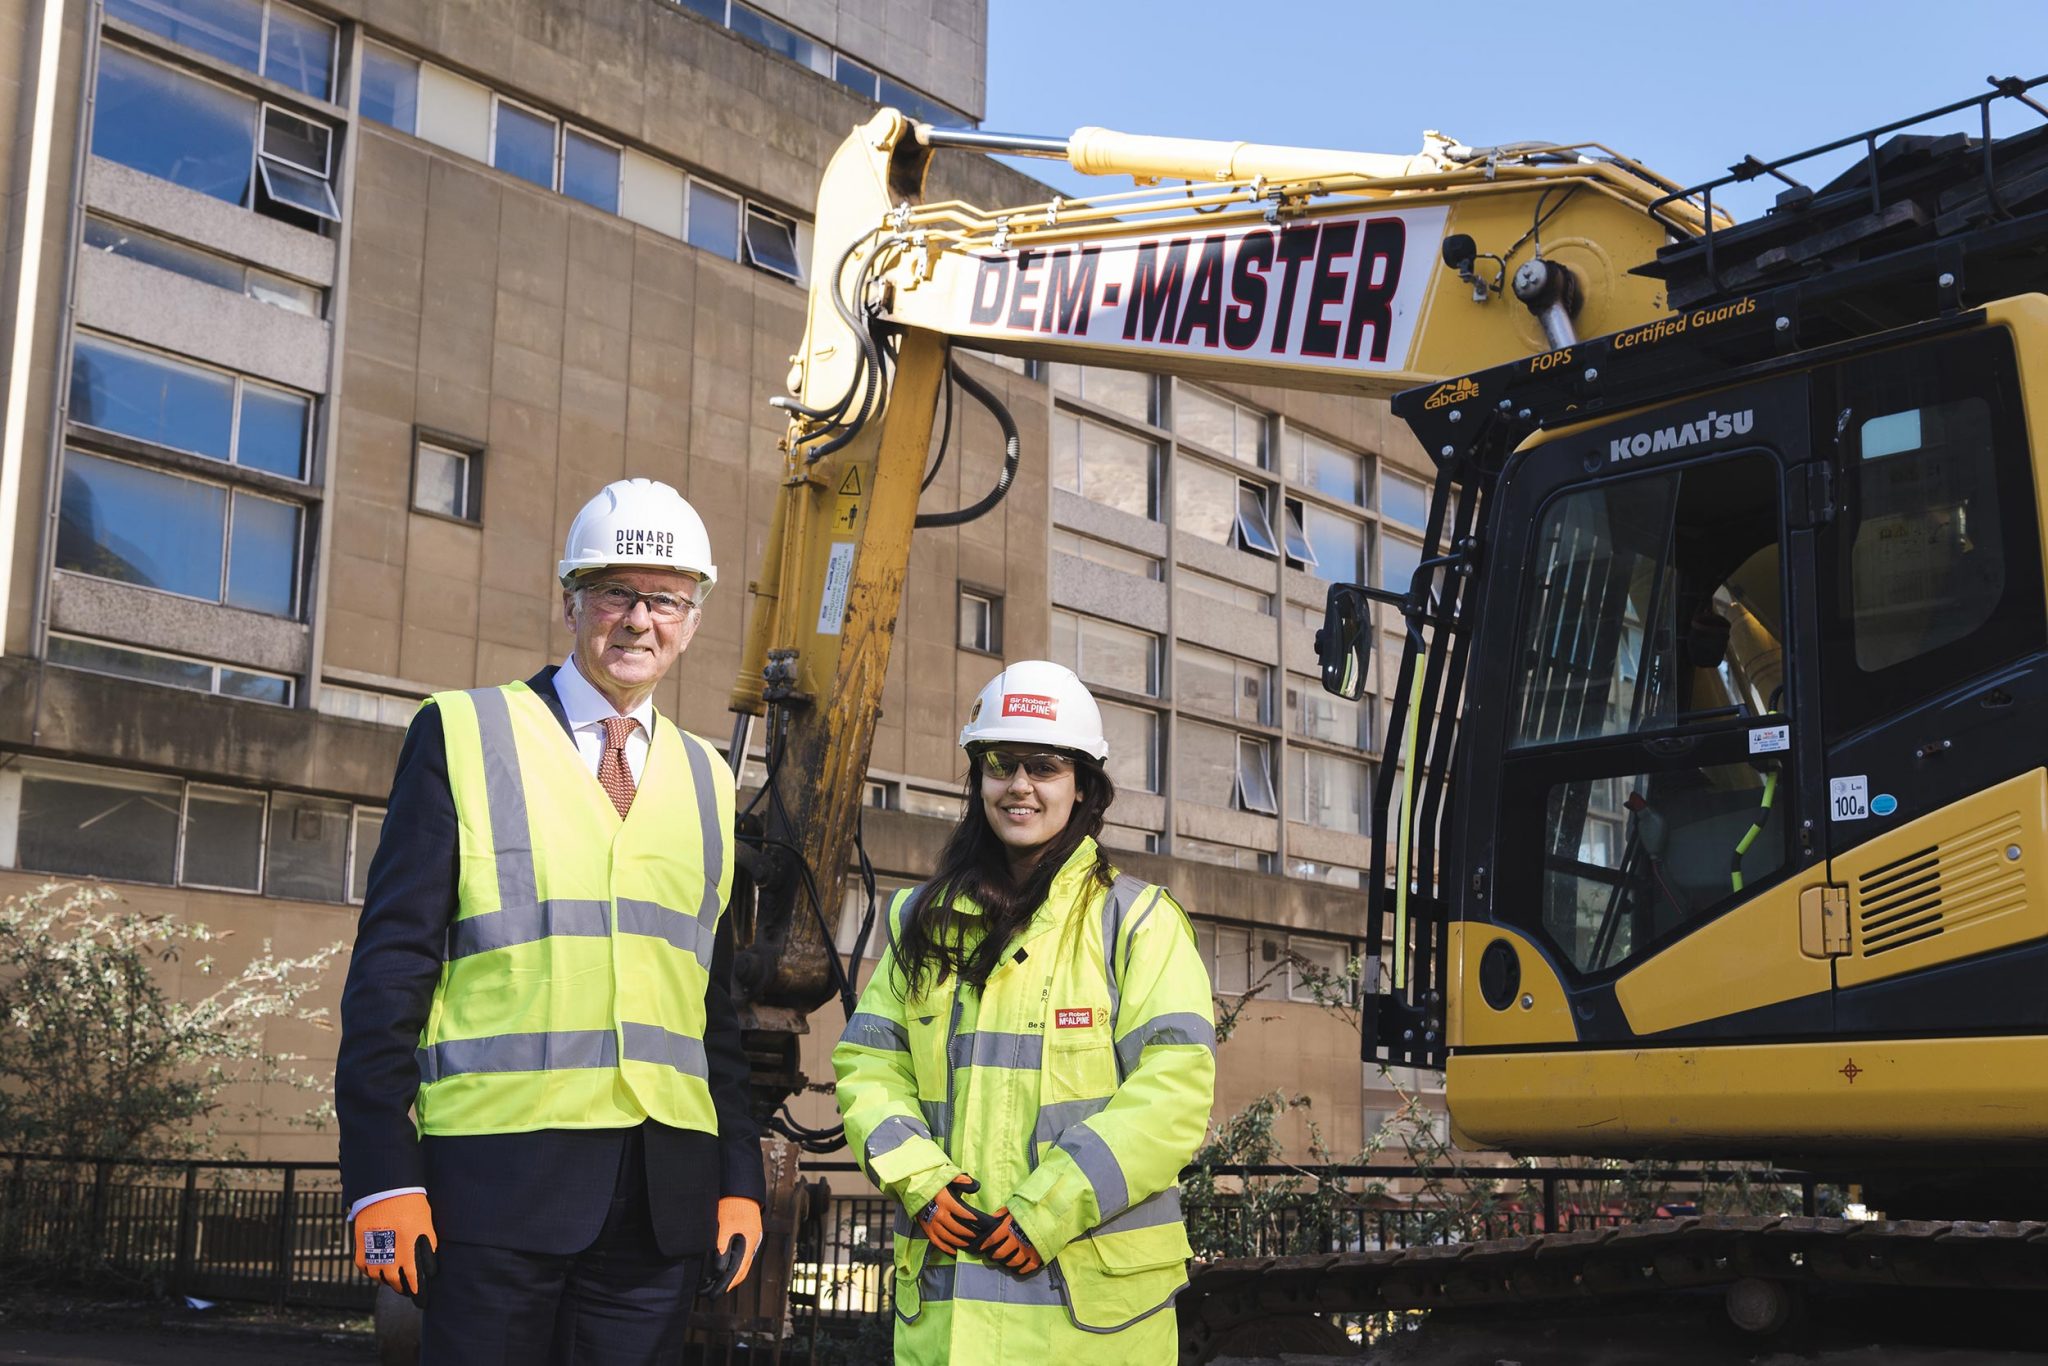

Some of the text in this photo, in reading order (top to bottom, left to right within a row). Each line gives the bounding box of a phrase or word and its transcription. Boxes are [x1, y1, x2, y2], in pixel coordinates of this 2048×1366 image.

[969, 217, 1406, 362] DEM-MASTER
[1614, 297, 1757, 350] Certified Guards
[1530, 348, 1573, 374] FOPS
[1610, 409, 1754, 462] KOMATSU
[616, 529, 674, 544] DUNARD
[1022, 697, 1050, 706] Robert
[1835, 795, 1857, 817] 100
